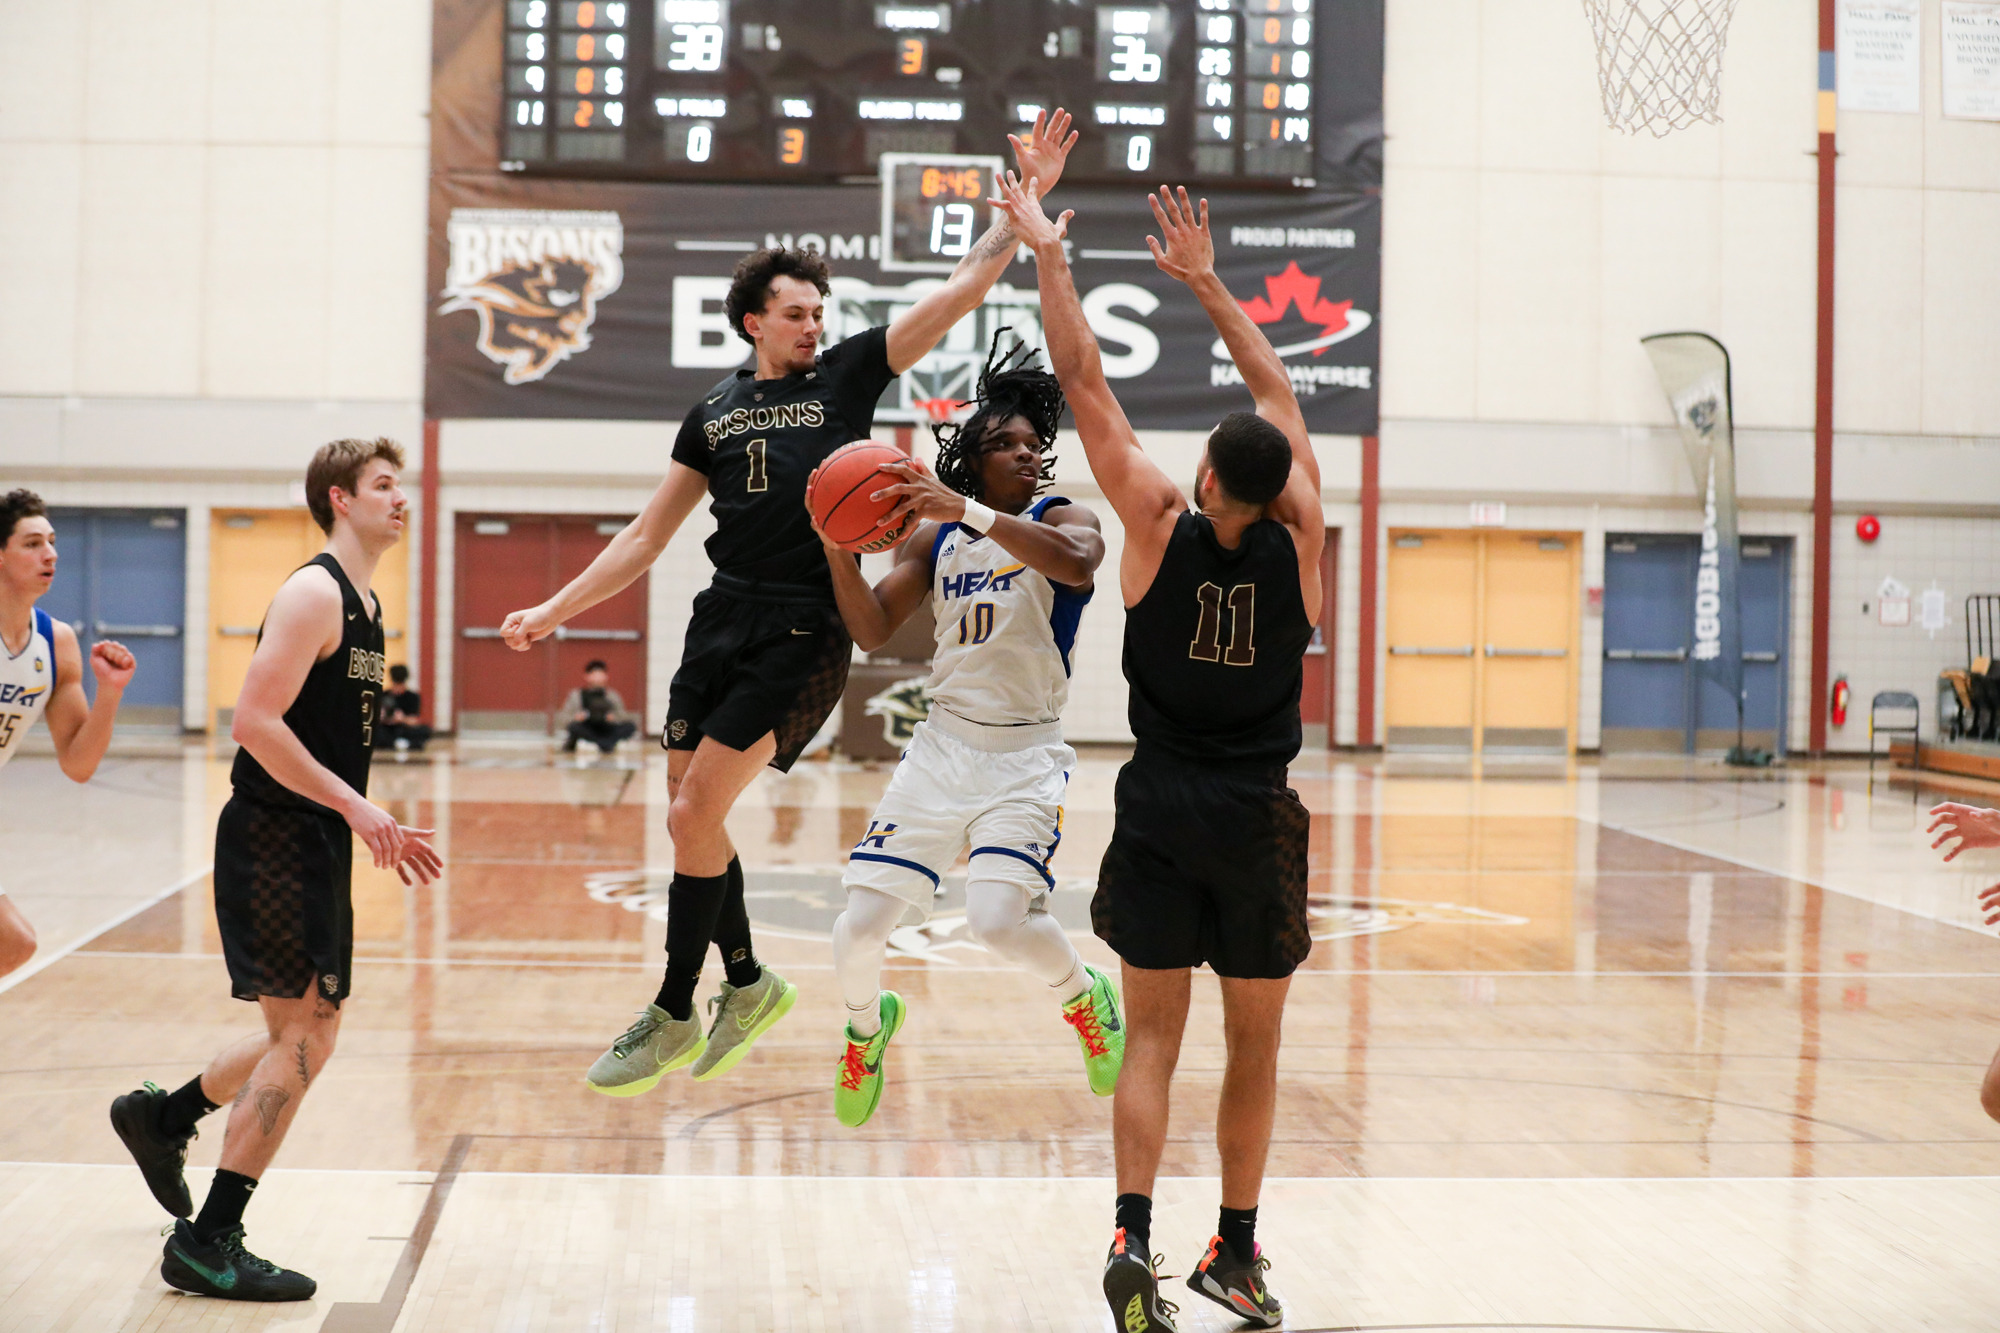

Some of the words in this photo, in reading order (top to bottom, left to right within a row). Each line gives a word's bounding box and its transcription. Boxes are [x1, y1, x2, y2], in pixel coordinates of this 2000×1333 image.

[668, 24, 723, 71] 38
[901, 39, 923, 74] 3
[1109, 35, 1162, 82] 36
[1271, 53, 1281, 75] 1
[517, 100, 544, 125] 11
[574, 100, 594, 127] 2
[1270, 118, 1280, 140] 1
[687, 126, 711, 162] 0
[781, 128, 804, 164] 3
[1127, 135, 1151, 171] 0
[930, 203, 974, 256] 13
[1231, 226, 1286, 247] PROUD
[1287, 228, 1355, 249] PARTNER
[450, 221, 622, 296] BISONS
[1211, 364, 1372, 389] KAAVERSE
[704, 400, 824, 451] BISONS
[746, 438, 768, 493] 1
[942, 563, 1027, 600] HEAT
[959, 602, 995, 645] 10
[1189, 581, 1255, 666] 11
[0, 684, 47, 707] EAT
